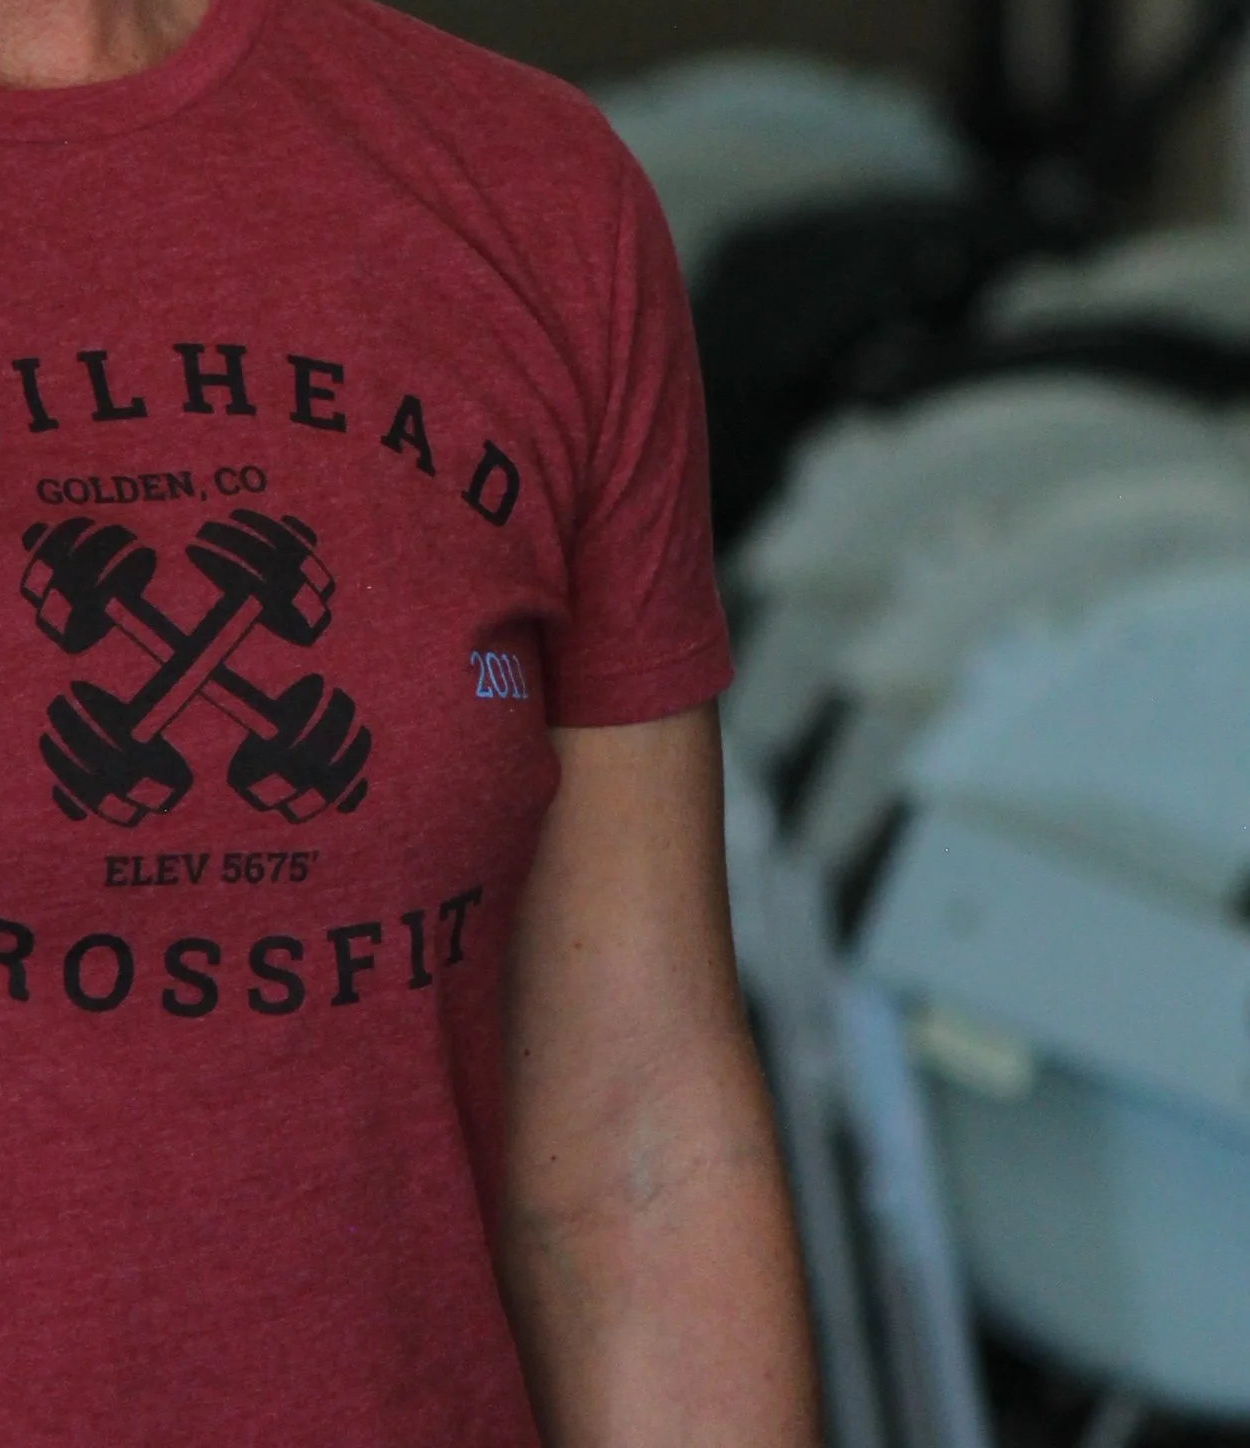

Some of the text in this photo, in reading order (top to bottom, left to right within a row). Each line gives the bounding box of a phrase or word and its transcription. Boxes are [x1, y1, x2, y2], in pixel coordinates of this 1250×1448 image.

[36, 466, 268, 506] GOLDEN, CO
[470, 651, 530, 700] 2011
[103, 851, 320, 889] ELEV 5675'
